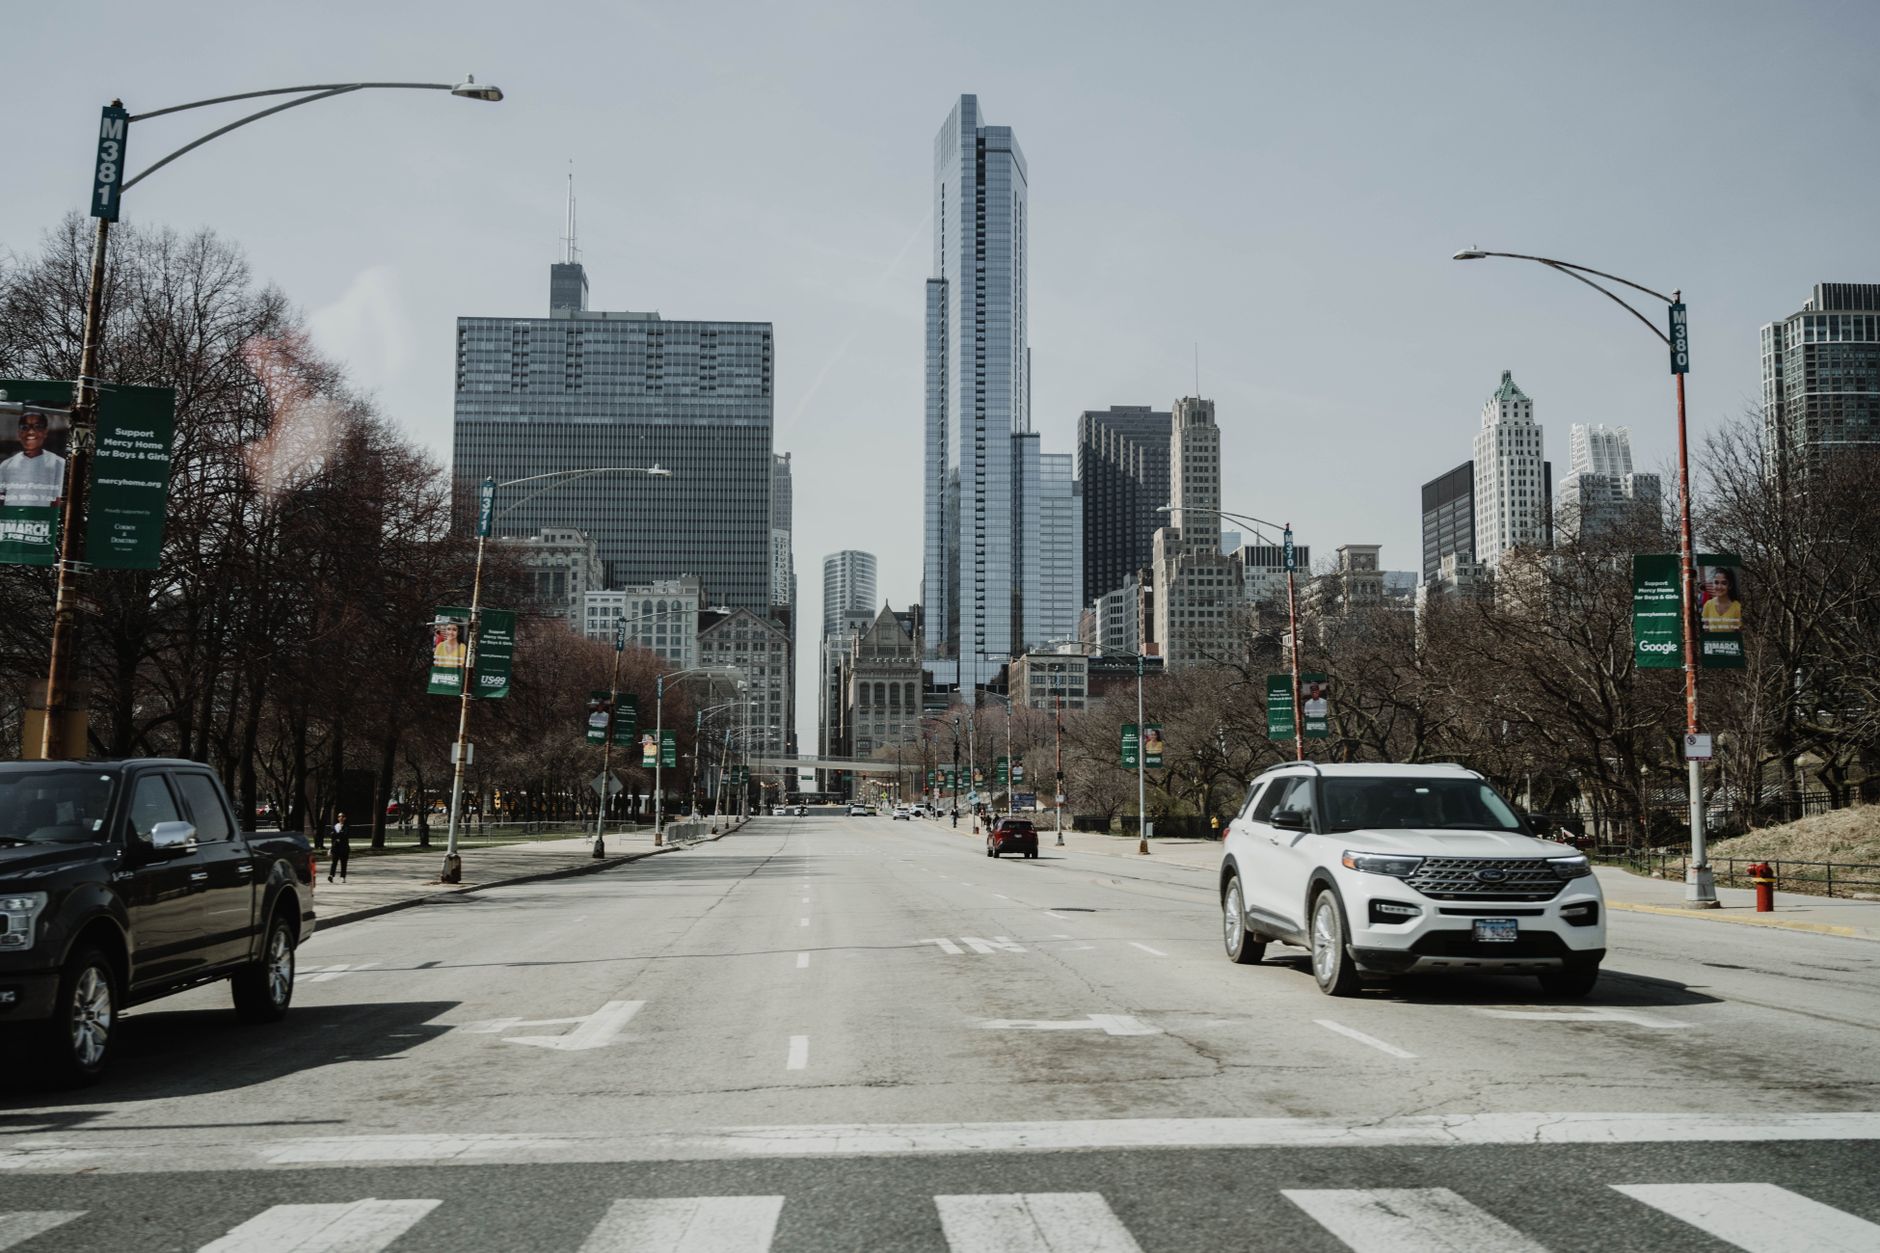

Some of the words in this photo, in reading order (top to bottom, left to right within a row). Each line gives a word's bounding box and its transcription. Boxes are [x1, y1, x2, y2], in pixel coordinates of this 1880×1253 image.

[98, 117, 124, 205] M381
[1673, 310, 1687, 366] M380
[115, 428, 154, 438] Support
[104, 438, 133, 448] Mercy
[135, 441, 163, 449] Home
[112, 450, 136, 459] Boys
[147, 453, 169, 461] Girls
[98, 478, 162, 488] mercyhome.org
[481, 487, 494, 530] M371
[5, 523, 50, 536] MARCH
[1285, 534, 1294, 567] M370
[1639, 640, 1678, 655] Google
